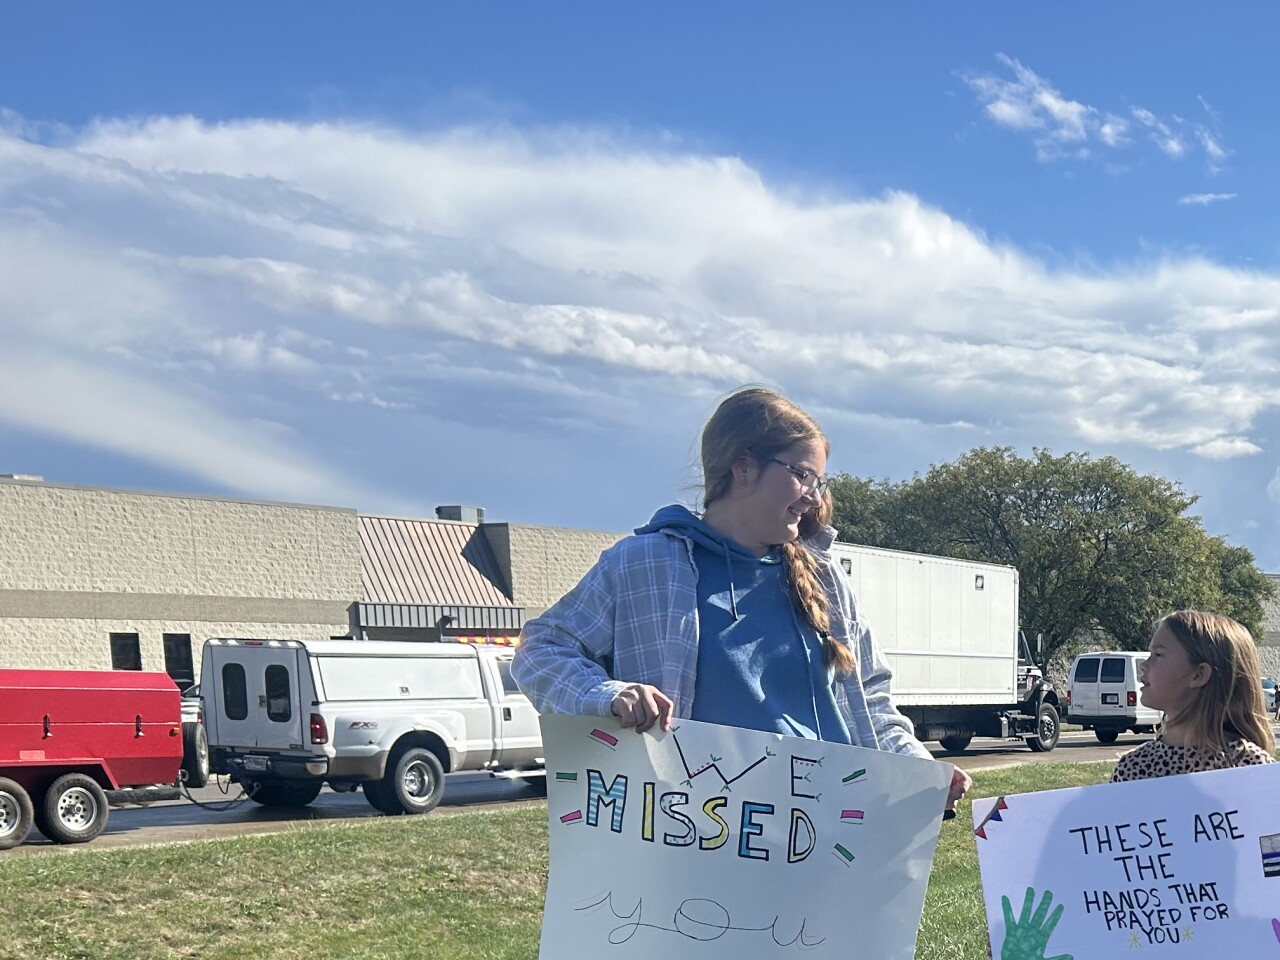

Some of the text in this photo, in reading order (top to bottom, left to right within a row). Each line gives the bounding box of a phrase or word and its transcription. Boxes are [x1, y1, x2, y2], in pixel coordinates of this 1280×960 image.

[671, 724, 822, 800] WE
[586, 768, 817, 863] MISSED
[1069, 810, 1245, 855] THESE ARE
[1113, 853, 1175, 882] THE
[1083, 882, 1219, 913] HANDS THAT
[1104, 903, 1230, 931] PRAYED FOR
[1141, 926, 1180, 944] YOU
